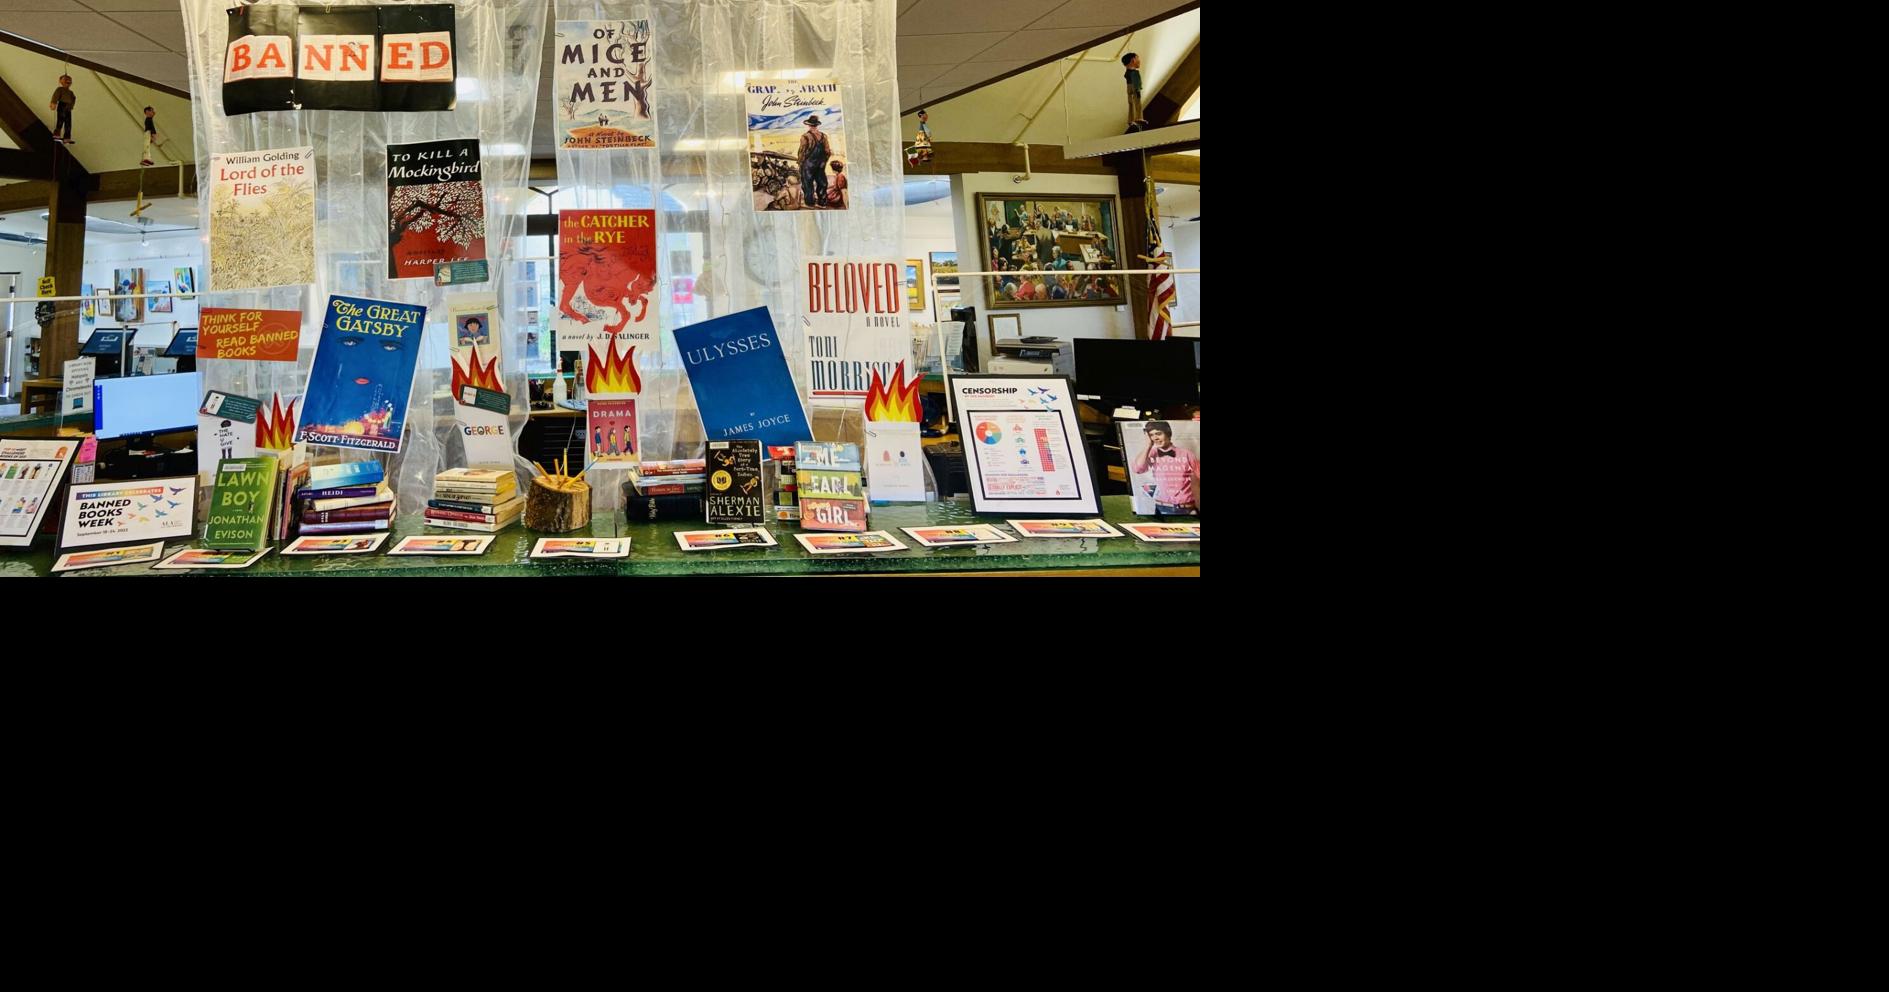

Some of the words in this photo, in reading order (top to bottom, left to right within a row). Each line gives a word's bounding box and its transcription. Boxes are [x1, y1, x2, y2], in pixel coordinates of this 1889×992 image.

[593, 28, 615, 39] OF
[231, 40, 451, 73] BANNED
[561, 42, 648, 64] MICE
[587, 67, 625, 78] AND
[570, 80, 642, 103] MEN
[747, 85, 780, 94] GRAP
[761, 95, 782, 111] John
[783, 95, 826, 108] Steinbeck
[595, 135, 652, 143] STEINBECK
[226, 156, 261, 165] William
[262, 152, 300, 162] Golding
[392, 153, 411, 162] TO
[417, 149, 453, 161] KILL
[459, 148, 468, 157] A
[220, 166, 257, 181] Lord
[261, 164, 277, 178] of
[281, 163, 304, 176] the
[388, 160, 480, 181] Mockingbird
[233, 182, 268, 196] Flies
[563, 216, 579, 228] the
[580, 215, 650, 228] CATCHER
[564, 236, 573, 244] in
[576, 231, 592, 244] the
[594, 231, 626, 244] RYE
[403, 258, 445, 266] HARPER
[808, 262, 900, 314] BELOVED
[202, 313, 237, 325] THINK
[240, 311, 263, 322] FOR
[332, 299, 363, 316] The
[366, 304, 421, 324] GREAT
[202, 321, 260, 336] YOURSELF
[335, 315, 409, 338] GATSBY
[874, 316, 900, 328] NOVEL
[216, 336, 246, 348] READ
[249, 330, 299, 345] BANNED
[217, 346, 257, 358] BOOKS
[686, 332, 772, 366] ULYSSES
[808, 335, 838, 358] TONI
[811, 360, 900, 391] MORRIO
[962, 387, 1018, 395] CENSORSHIP
[593, 410, 632, 418] DRAMA
[464, 424, 504, 436] GEORGE
[723, 422, 754, 437] JAMES
[757, 413, 791, 429] JOYCE
[340, 434, 395, 449] FITZGERALD
[816, 446, 838, 467] ME
[218, 472, 271, 487] LAWN
[811, 475, 852, 495] EARL
[80, 499, 131, 510] BANNED
[221, 491, 260, 506] BOY
[710, 496, 759, 505] SHERMAN
[78, 508, 123, 519] BOOKS
[711, 505, 761, 516] ALEXIE
[816, 506, 851, 526] GIRL
[78, 517, 114, 528] WEEK
[209, 515, 264, 525] JONATHAN
[215, 530, 253, 539] EVISON
